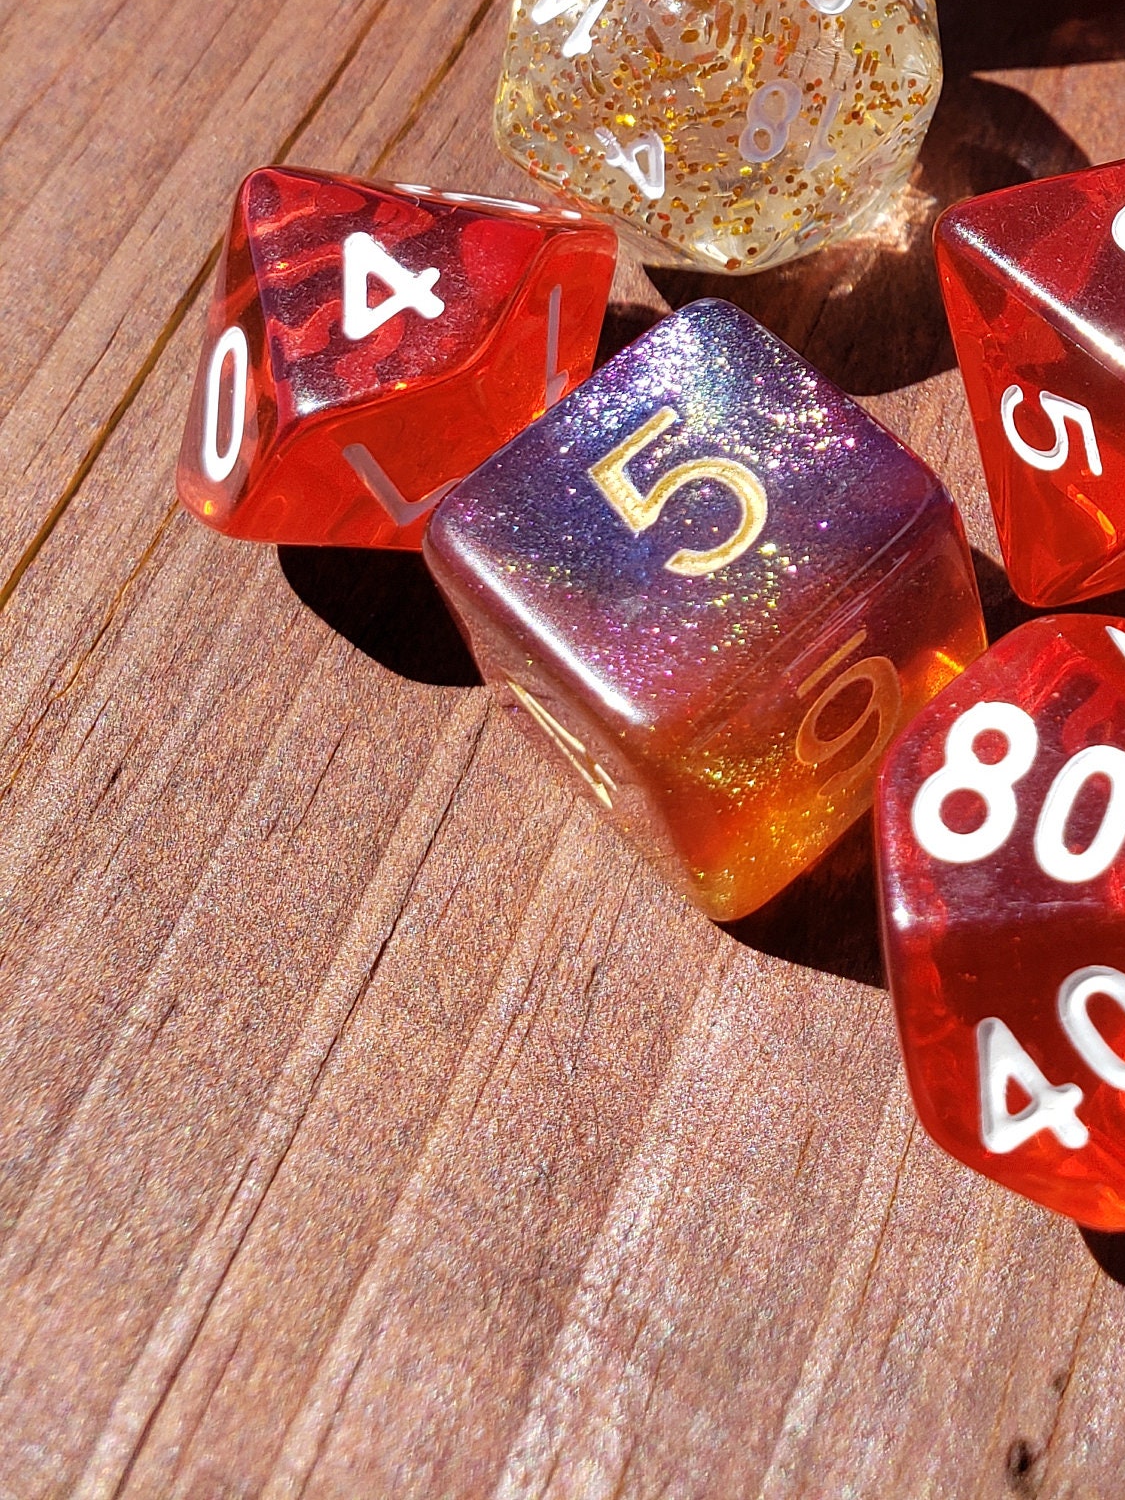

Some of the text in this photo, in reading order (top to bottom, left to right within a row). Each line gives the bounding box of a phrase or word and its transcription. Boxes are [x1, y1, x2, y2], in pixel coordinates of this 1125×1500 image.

[594, 127, 666, 200] 4
[342, 231, 445, 341] 4
[203, 325, 249, 483] 0
[1000, 384, 1103, 476] 5
[587, 406, 769, 577] 5
